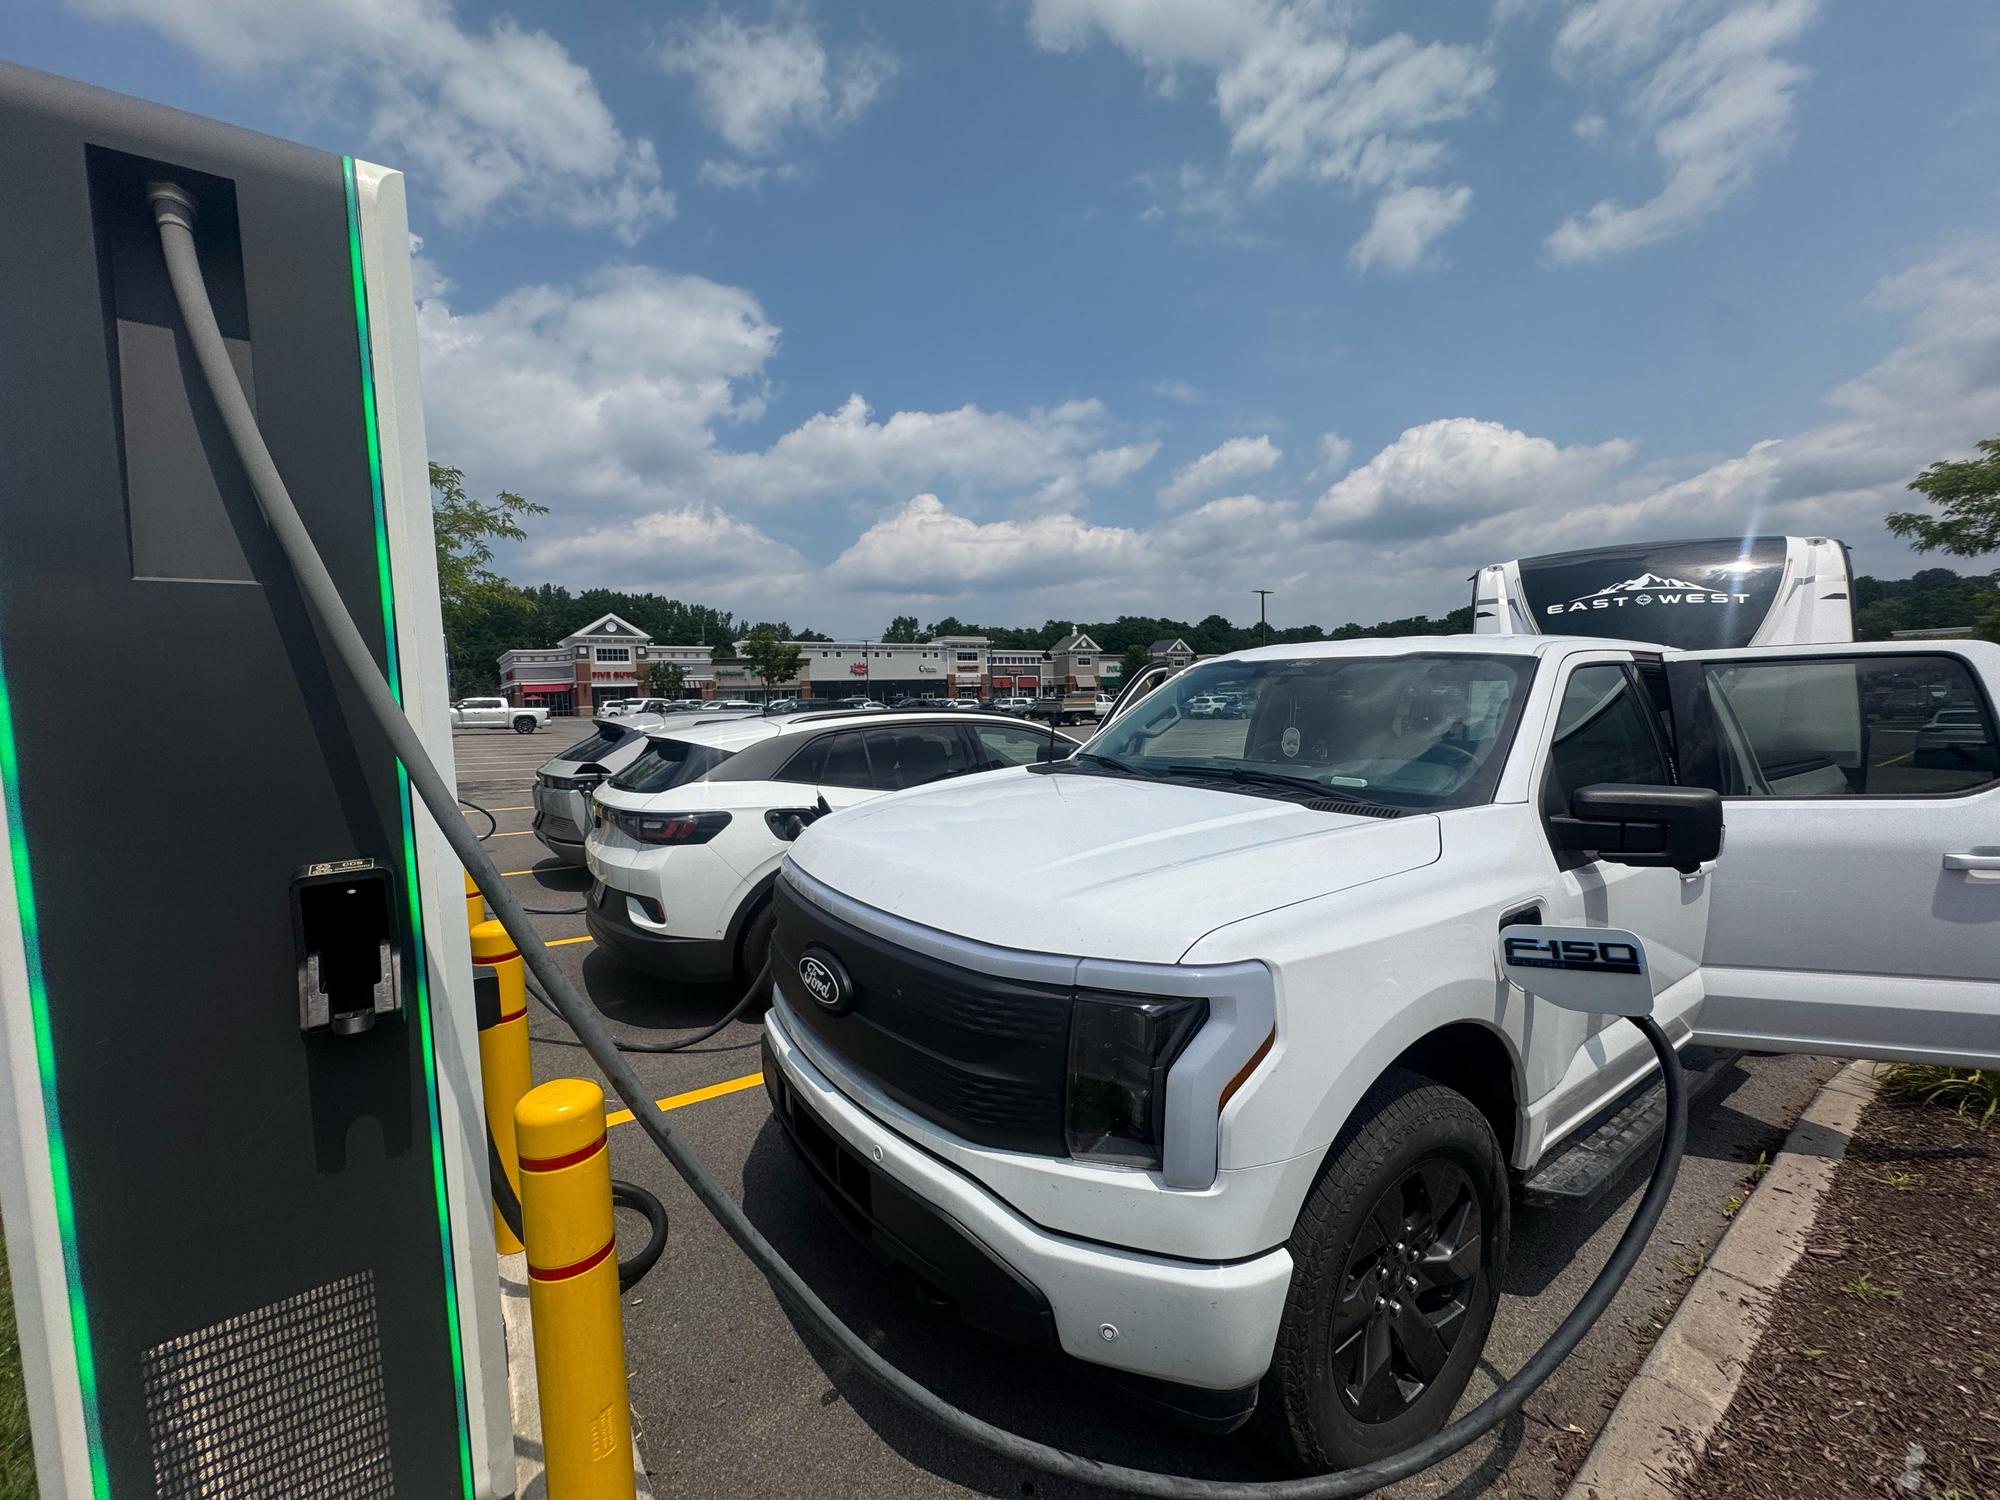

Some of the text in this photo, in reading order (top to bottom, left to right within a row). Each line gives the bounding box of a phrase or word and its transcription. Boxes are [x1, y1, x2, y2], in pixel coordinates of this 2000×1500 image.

[1546, 593, 1750, 615] EAST WEST
[1504, 937, 1639, 966] F-150
[804, 961, 831, 999] Ford
